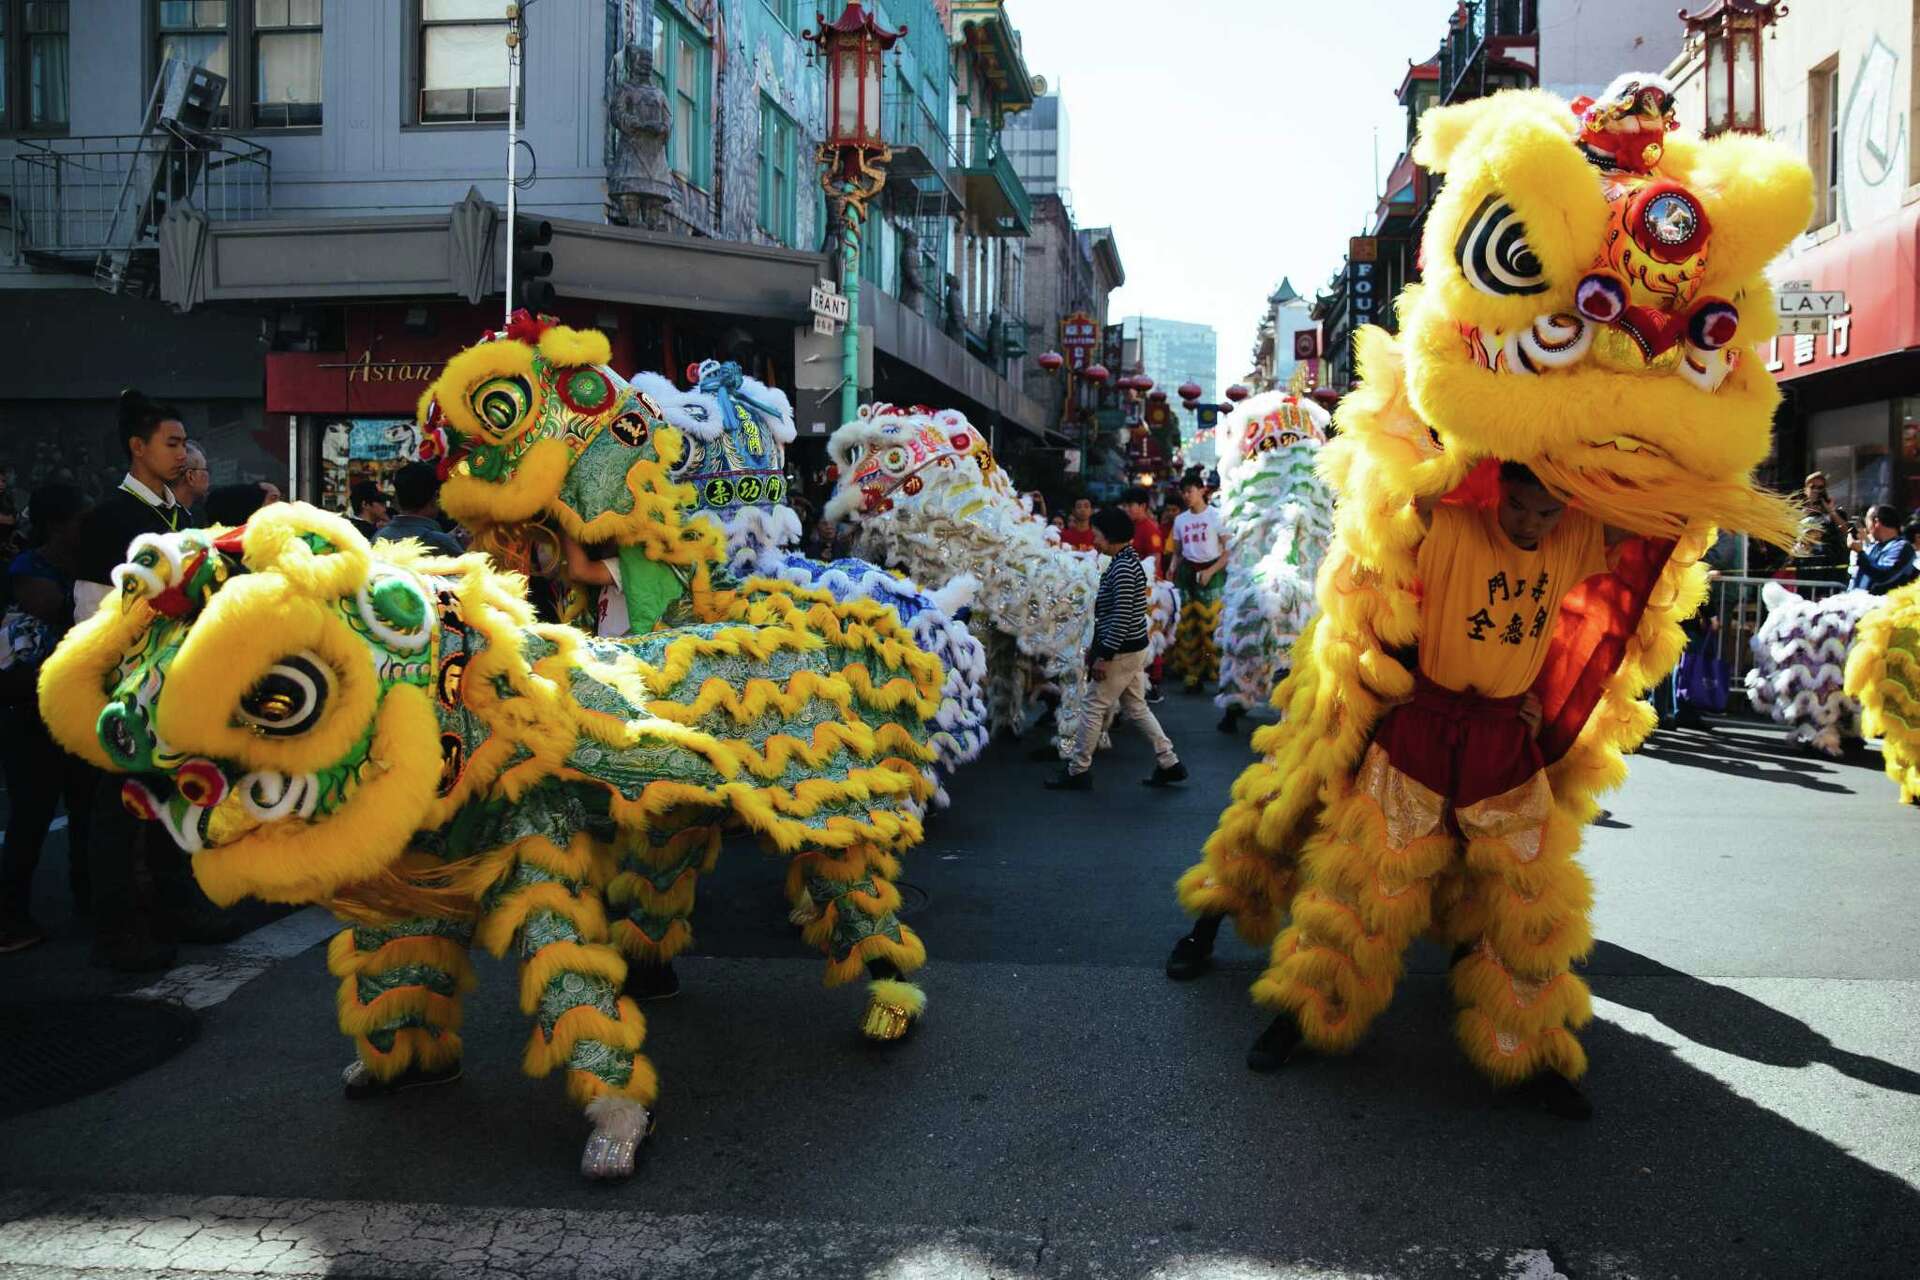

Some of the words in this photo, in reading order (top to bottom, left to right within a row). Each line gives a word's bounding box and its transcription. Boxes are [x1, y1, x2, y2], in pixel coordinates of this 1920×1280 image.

[814, 291, 846, 316] GRANT
[1780, 296, 1834, 311] LAY
[349, 350, 433, 383] Asian
